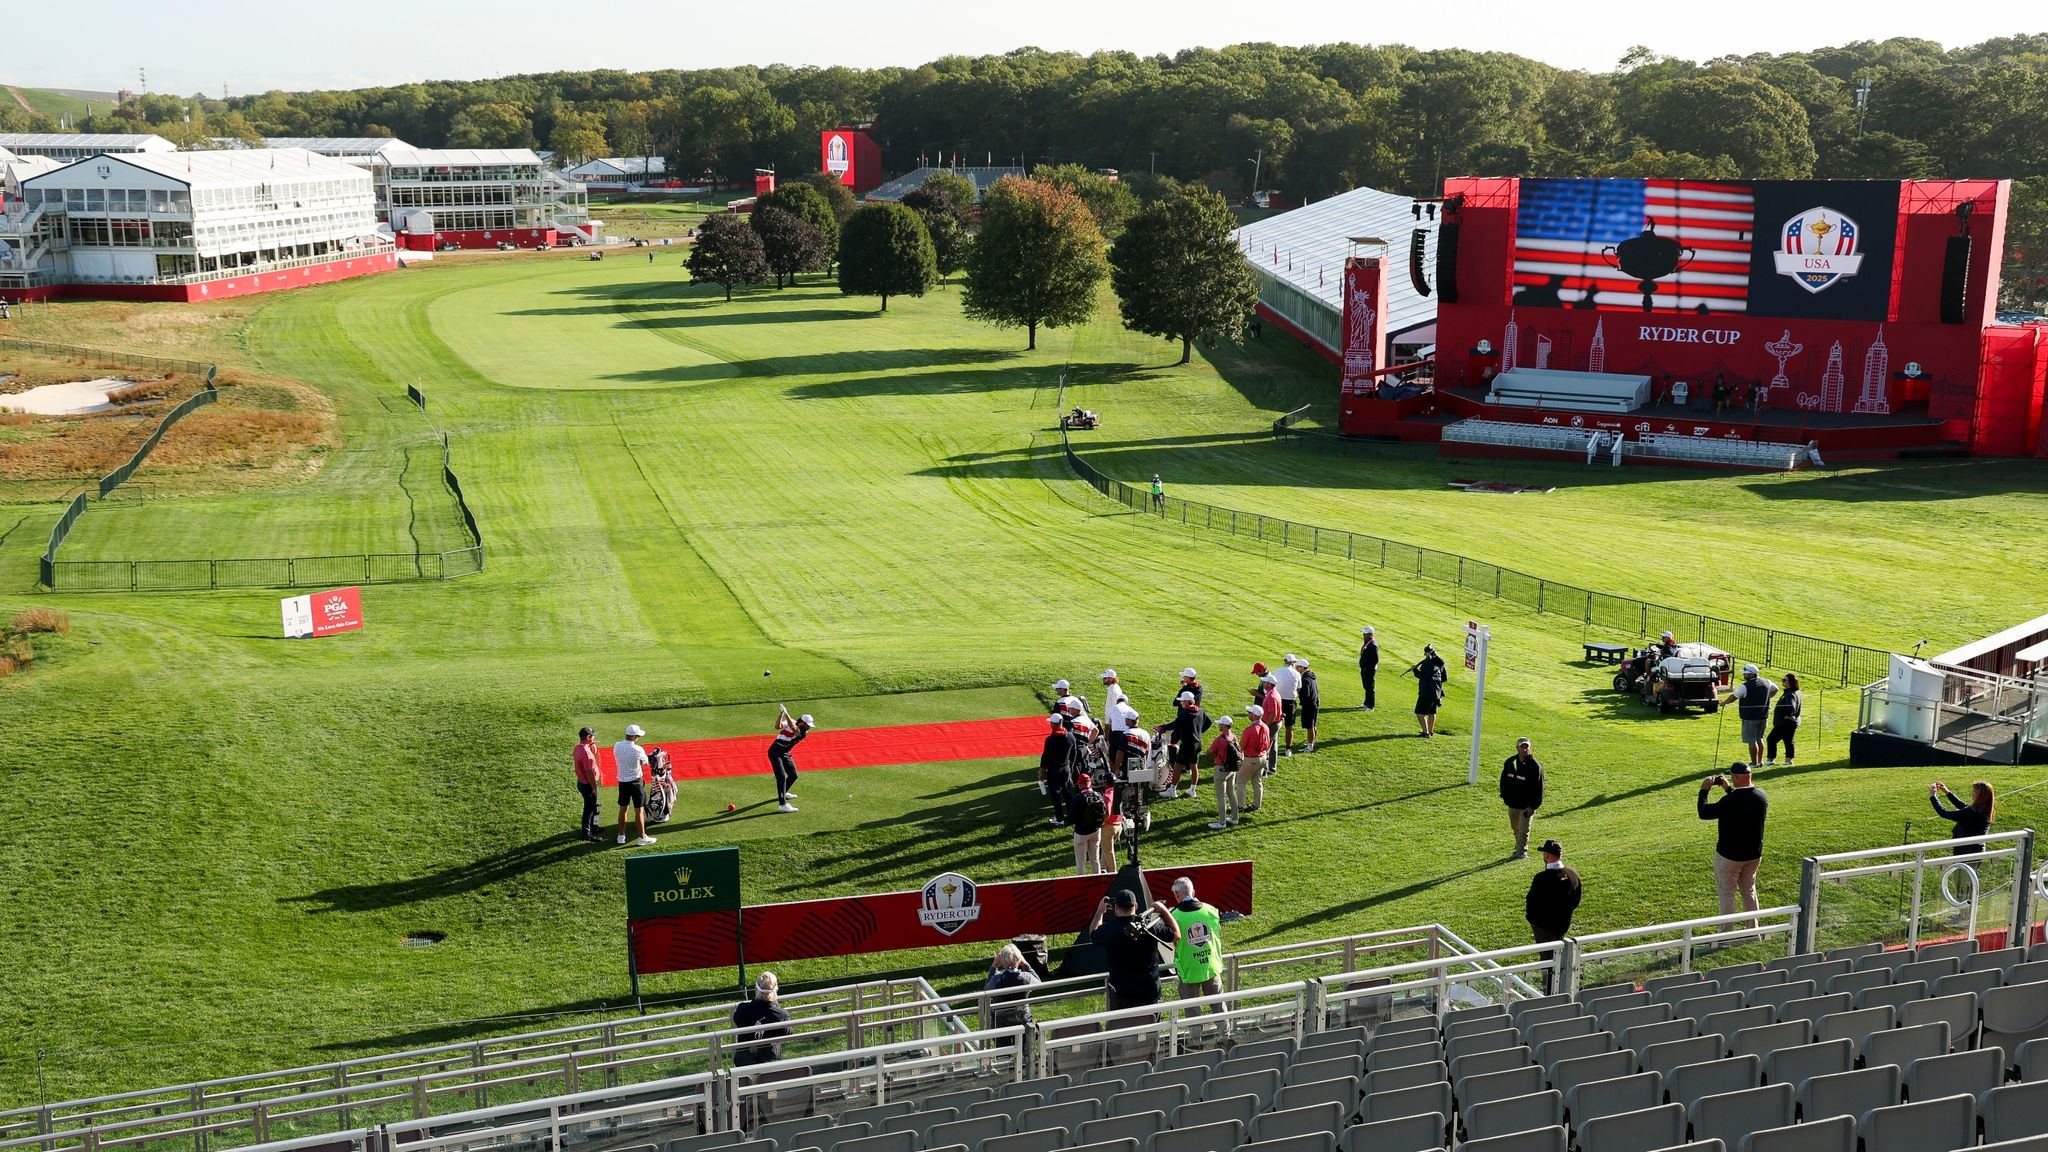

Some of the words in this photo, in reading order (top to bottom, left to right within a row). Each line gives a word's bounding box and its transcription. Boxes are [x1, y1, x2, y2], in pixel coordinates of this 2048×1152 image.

[1804, 258, 1831, 269] USA
[1806, 274, 1828, 282] 2025
[1638, 326, 1700, 343] RYDER
[1701, 329, 1741, 345] CUP
[1543, 416, 1559, 424] AON
[1634, 422, 1651, 432] citi
[293, 600, 299, 613] 1
[324, 601, 348, 613] PGA
[653, 886, 716, 903] ROLEX
[924, 911, 956, 921] RYDER
[957, 909, 977, 918] CUP
[1193, 949, 1211, 959] PHOTO
